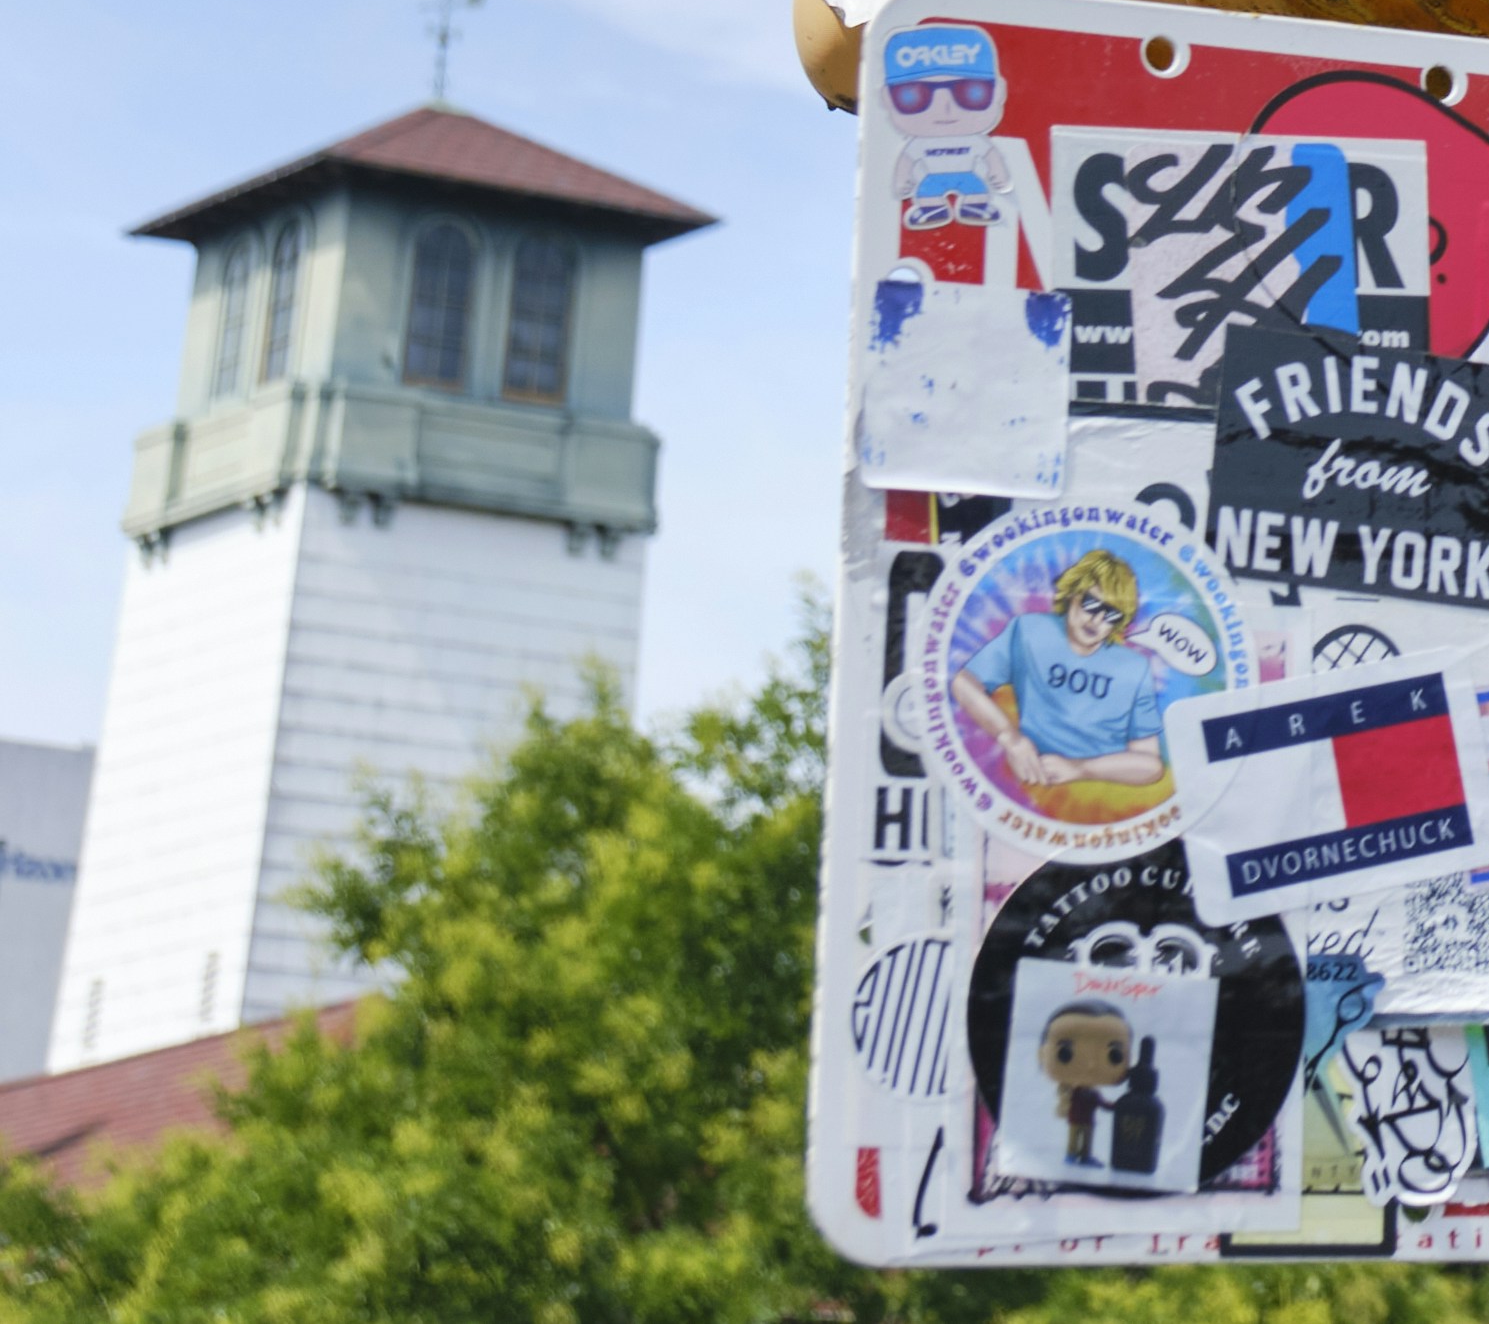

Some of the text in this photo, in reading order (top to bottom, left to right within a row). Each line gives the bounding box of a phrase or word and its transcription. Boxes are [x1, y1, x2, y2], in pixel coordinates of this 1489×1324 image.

[1303, 438, 1433, 499] from
[1215, 506, 1340, 578] NEW
[1240, 816, 1456, 886] DVORNECHUCK
[1024, 864, 1132, 949] TATTOO
